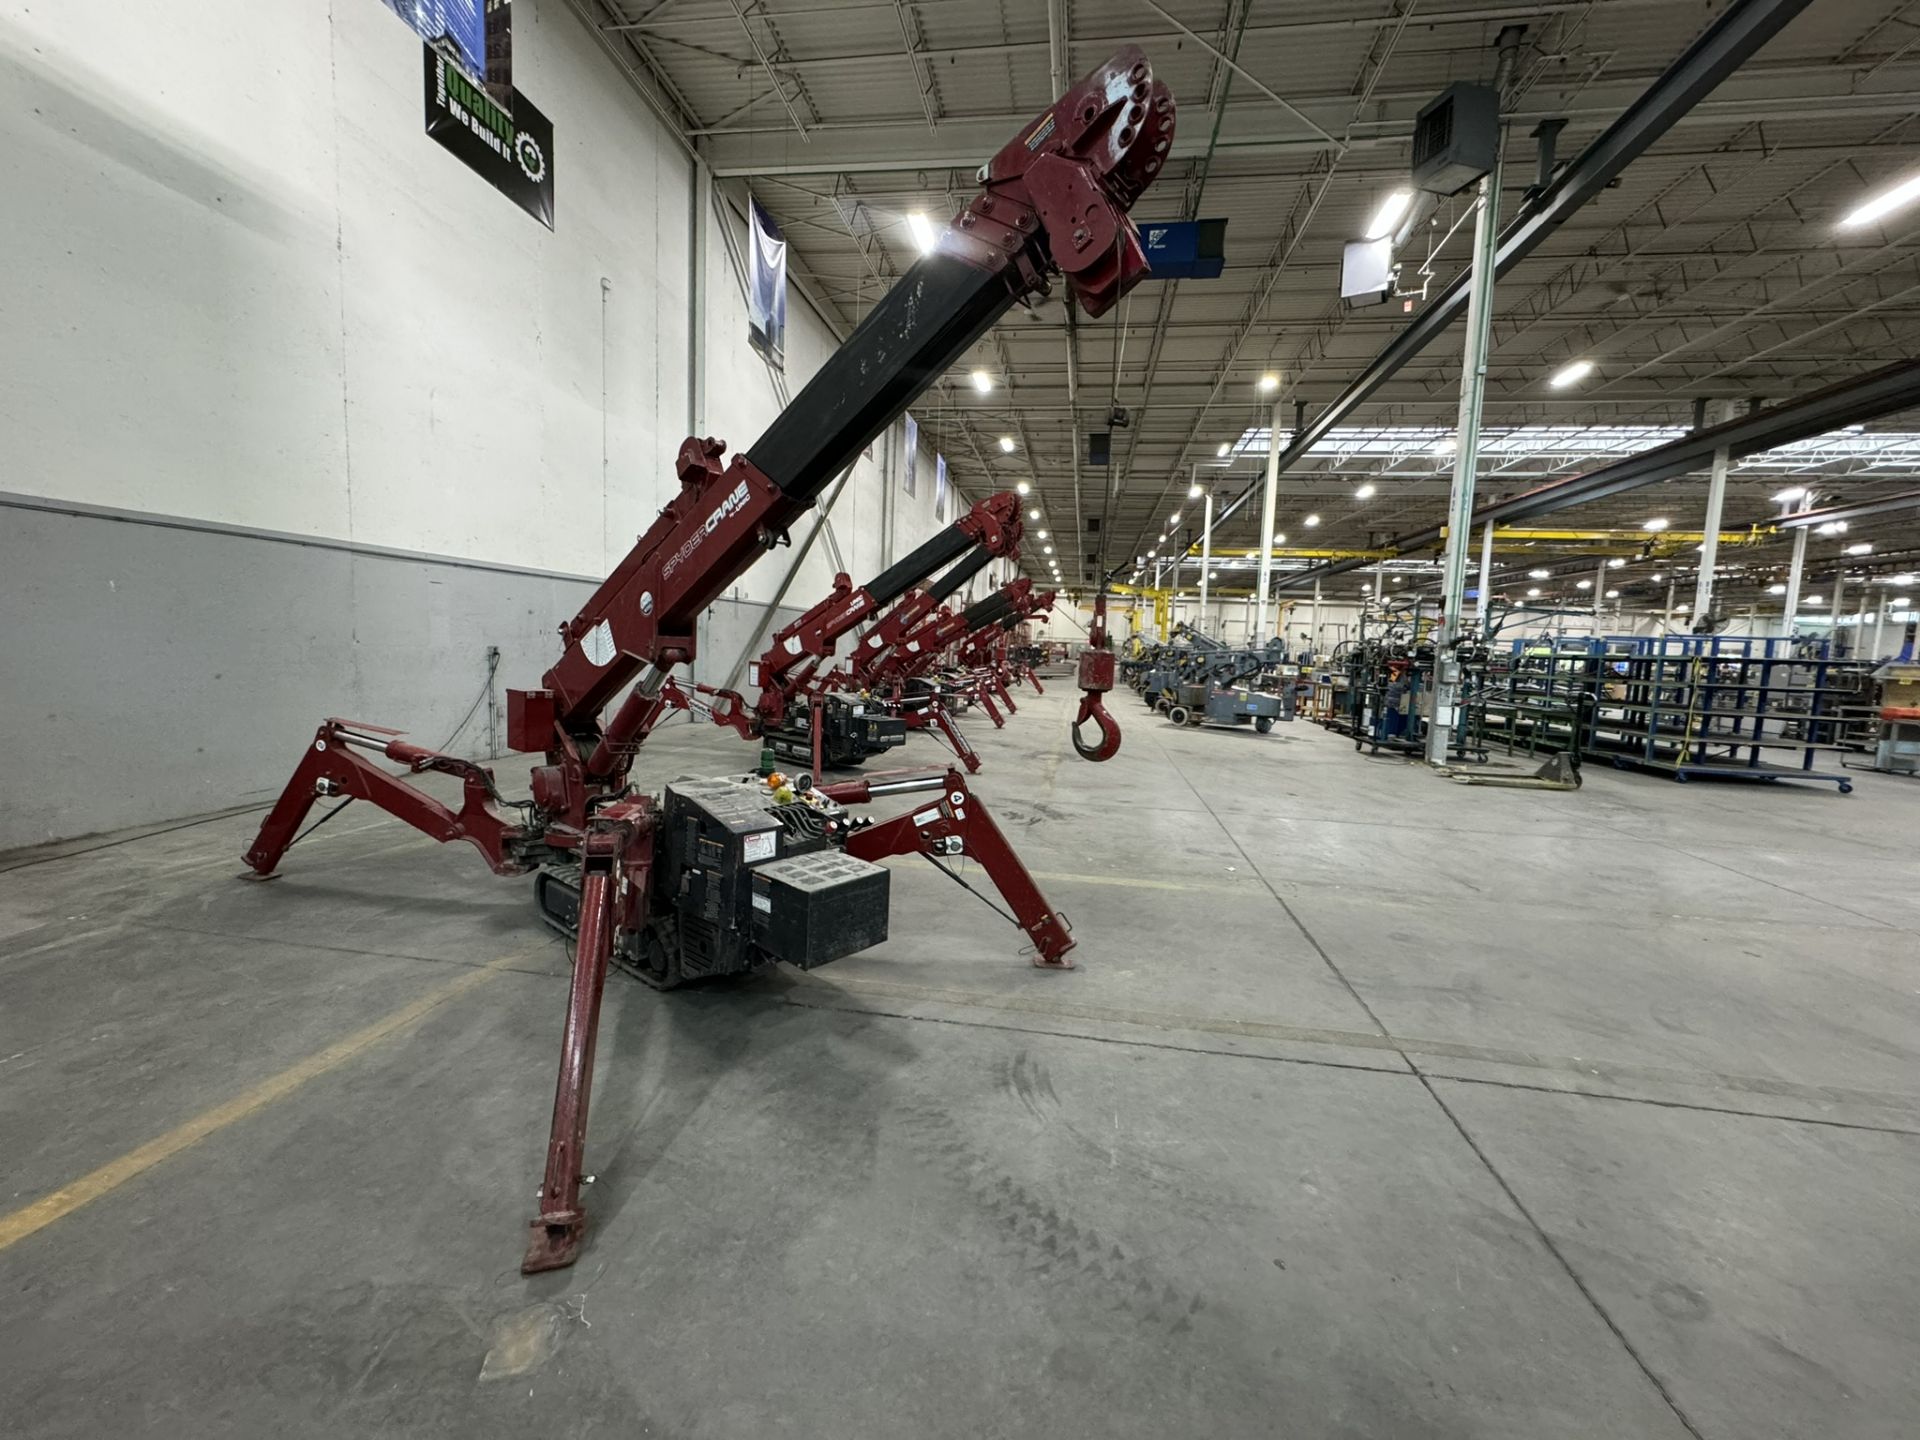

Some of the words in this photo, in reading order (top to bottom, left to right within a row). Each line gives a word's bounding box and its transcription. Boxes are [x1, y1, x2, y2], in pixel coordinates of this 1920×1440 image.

[436, 54, 447, 108] Together
[445, 63, 514, 147] Quality
[449, 96, 469, 126] We
[471, 115, 501, 154] Build
[502, 142, 512, 162] It
